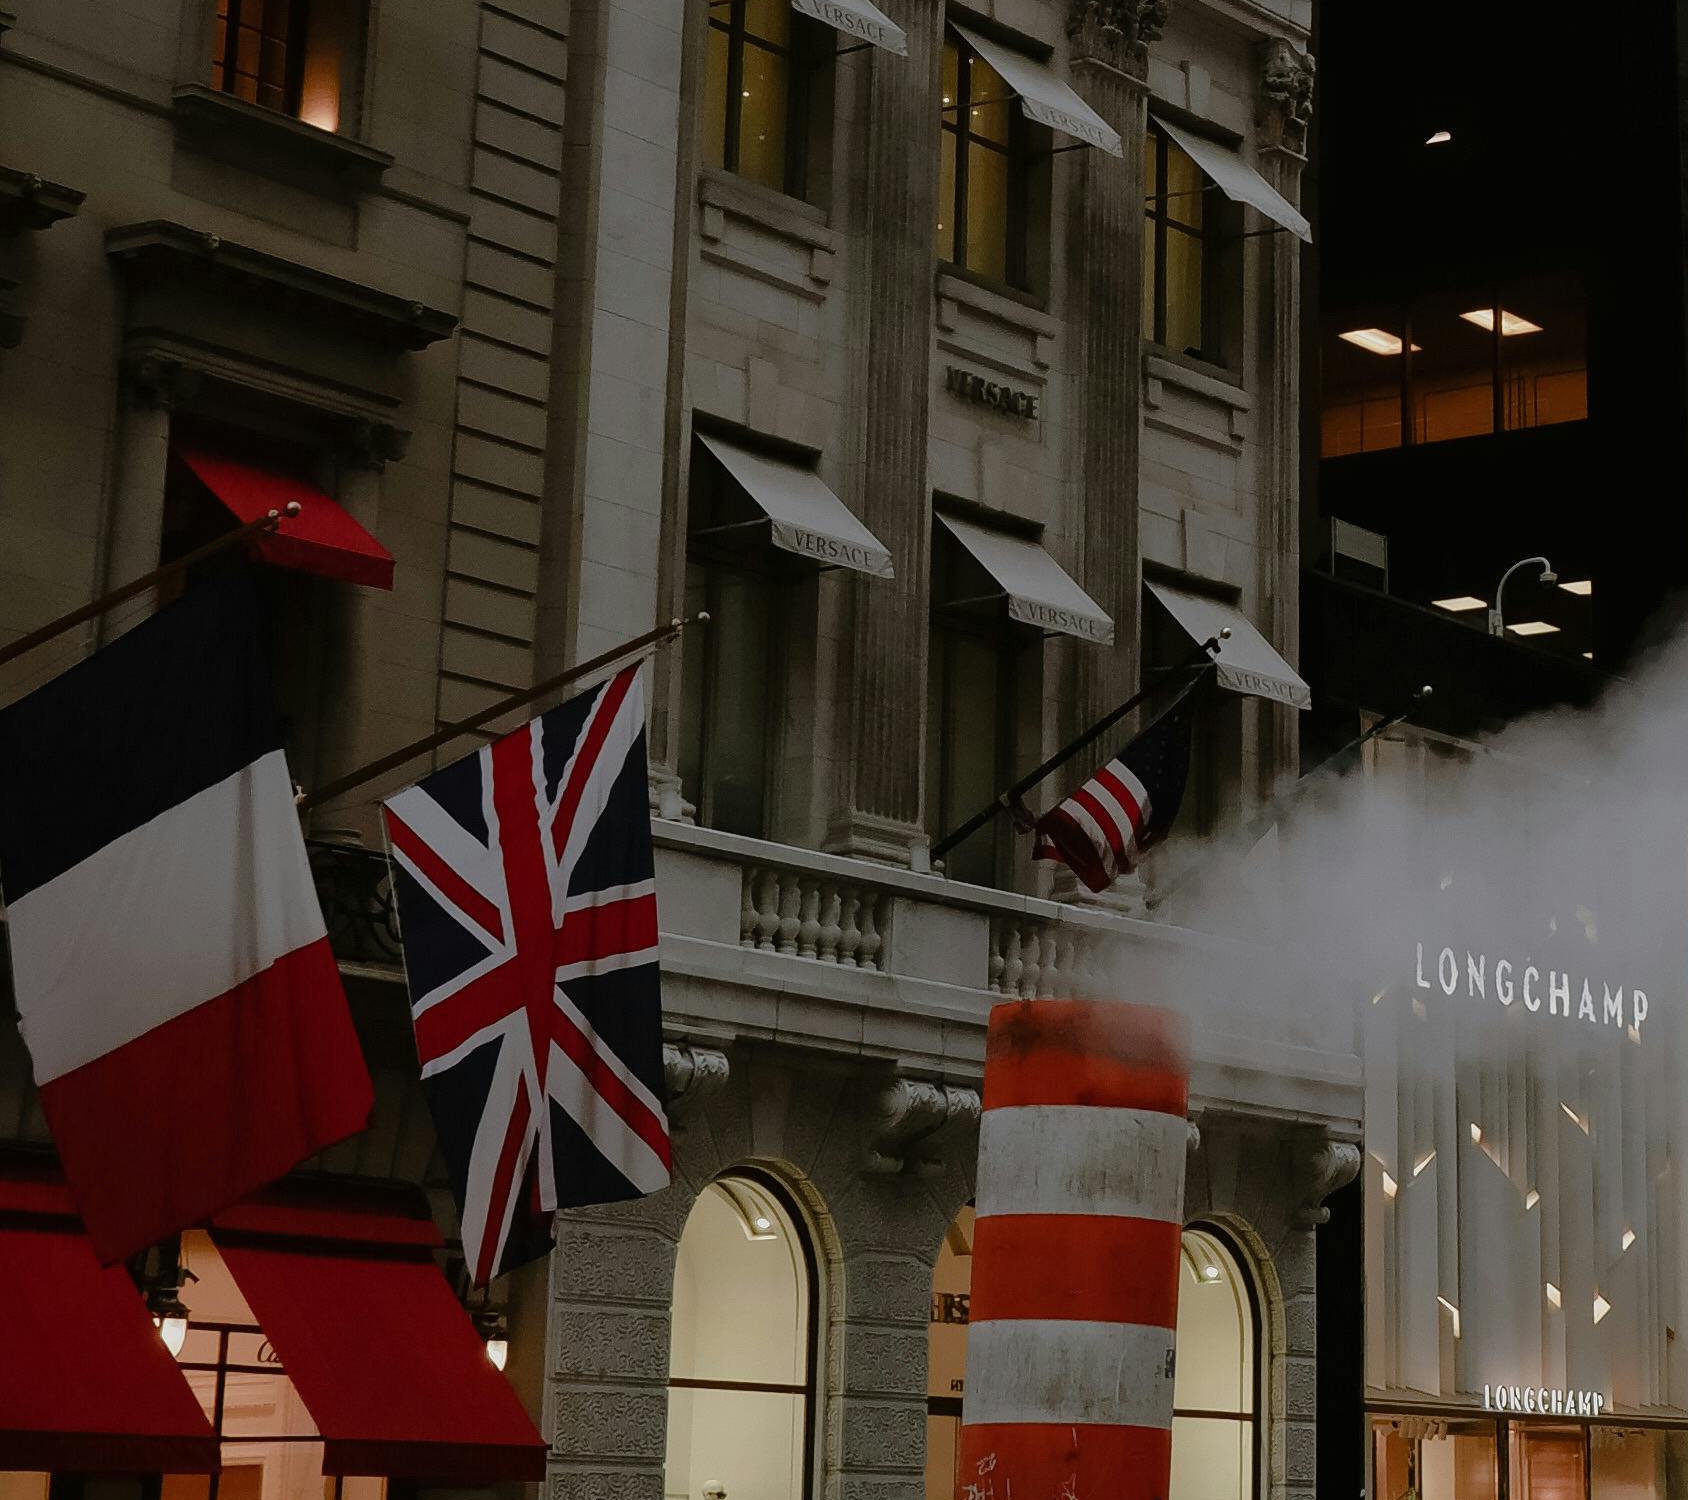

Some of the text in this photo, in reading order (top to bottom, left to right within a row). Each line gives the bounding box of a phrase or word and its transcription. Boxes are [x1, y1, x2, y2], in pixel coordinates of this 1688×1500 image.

[945, 365, 1039, 420] VERSACE
[795, 528, 871, 568] VERSACE
[1028, 602, 1096, 636] VERSACE
[1416, 942, 1649, 1031] LONGCHAMP
[1484, 1384, 1605, 1416] LONGCHAMP
